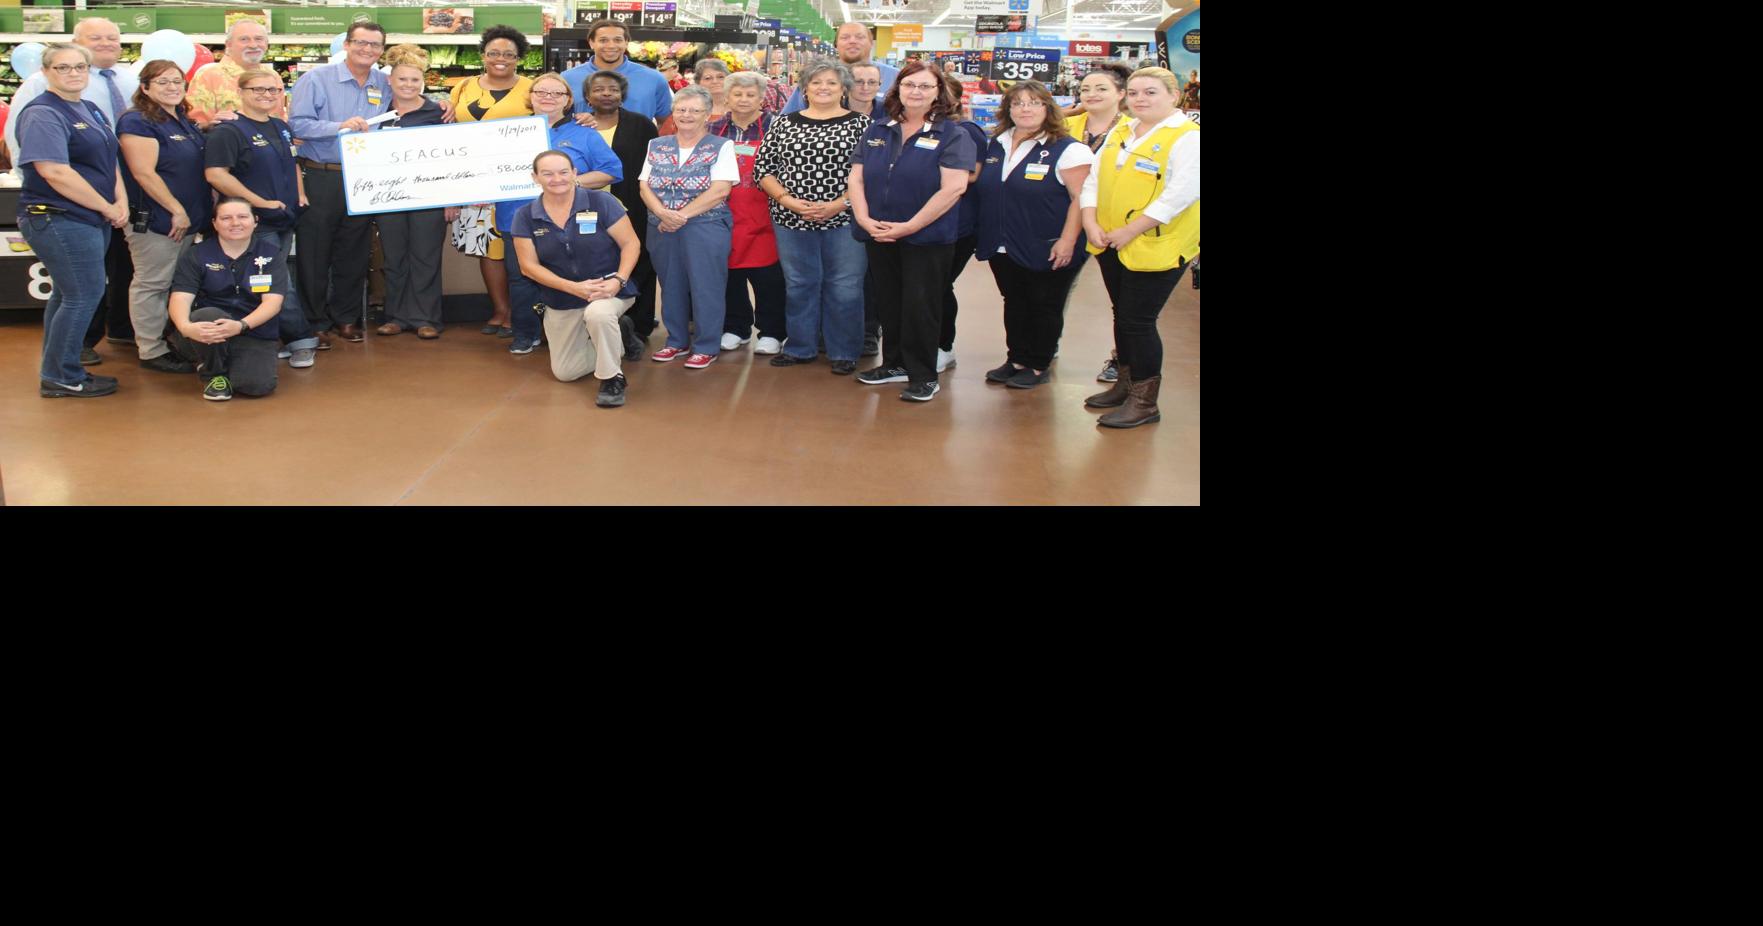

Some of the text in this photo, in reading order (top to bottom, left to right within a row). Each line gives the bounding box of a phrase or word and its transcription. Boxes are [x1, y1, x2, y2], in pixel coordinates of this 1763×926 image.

[391, 146, 468, 163] SEACUS
[500, 182, 535, 191] Walmart
[28, 262, 54, 300] 8
